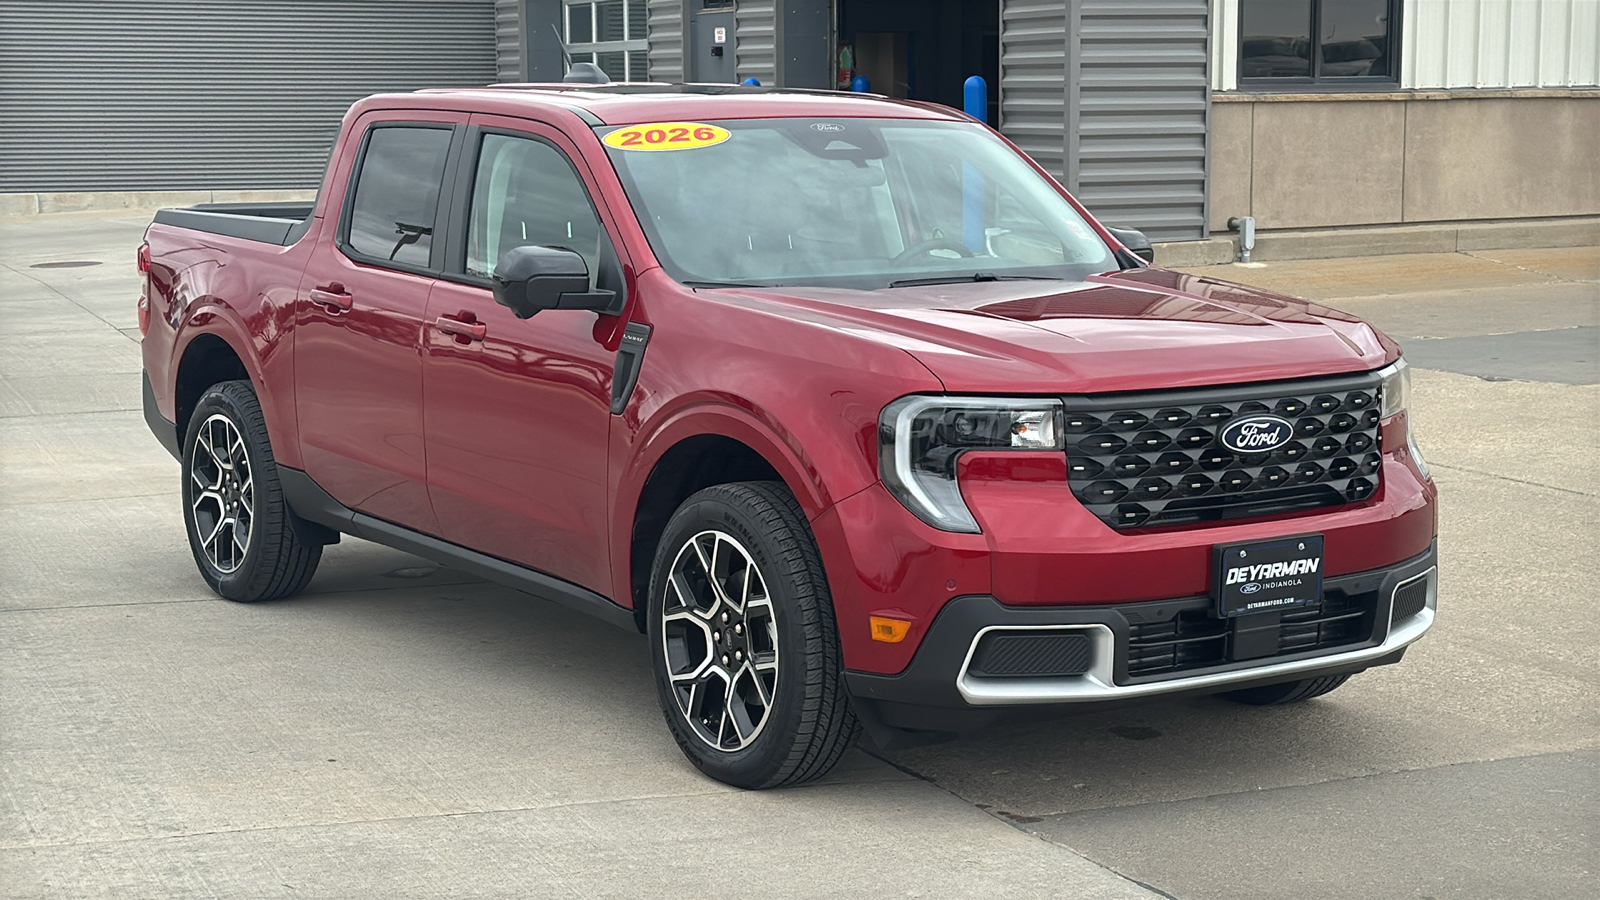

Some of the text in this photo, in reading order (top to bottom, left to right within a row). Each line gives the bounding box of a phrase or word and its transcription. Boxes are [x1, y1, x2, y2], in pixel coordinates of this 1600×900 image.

[620, 127, 716, 147] 2026
[1236, 421, 1282, 447] Ford
[1225, 557, 1320, 586] DEYARMAN
[1262, 578, 1302, 590] INDIANOLA
